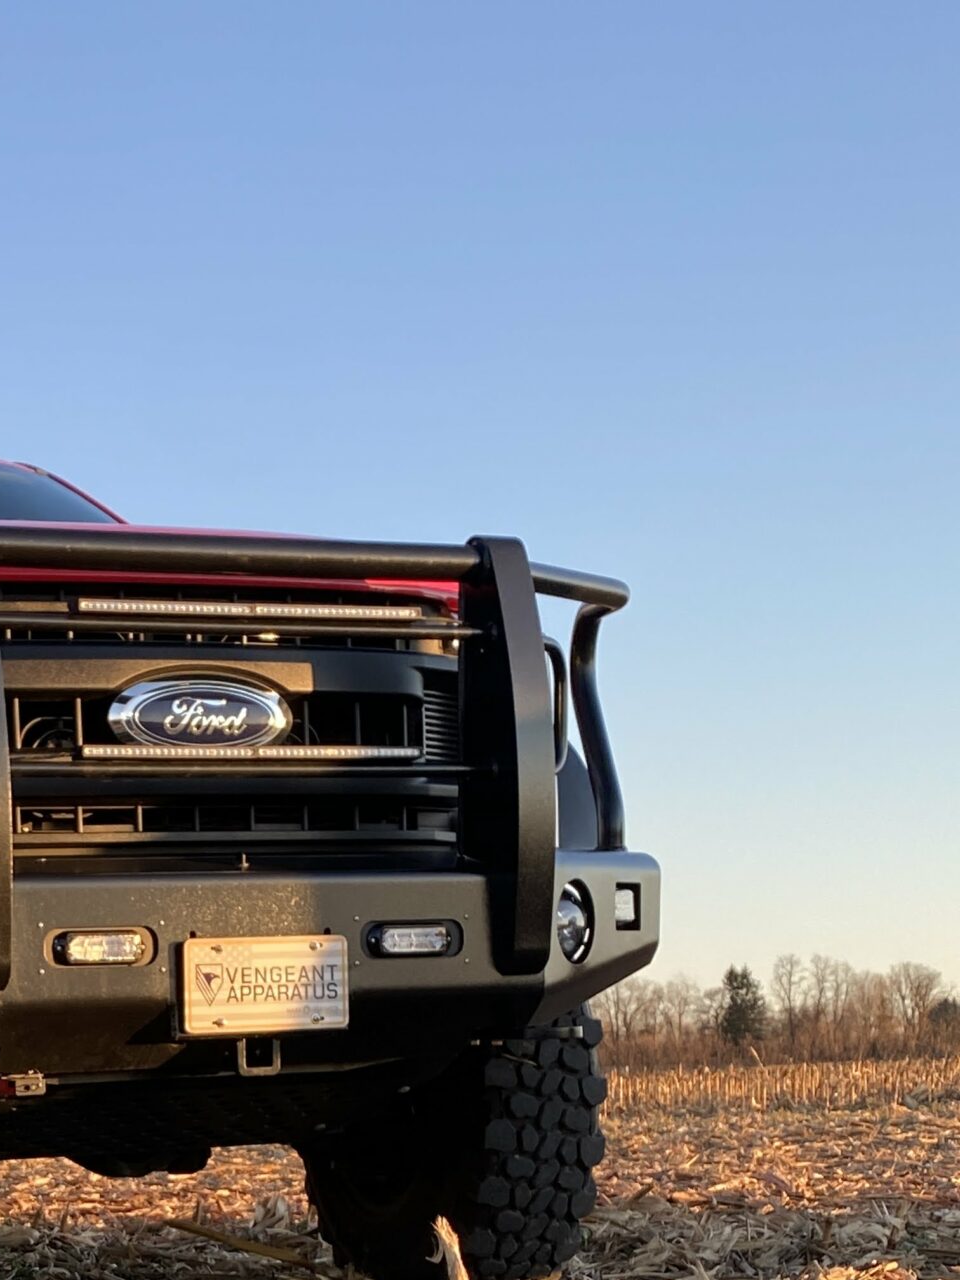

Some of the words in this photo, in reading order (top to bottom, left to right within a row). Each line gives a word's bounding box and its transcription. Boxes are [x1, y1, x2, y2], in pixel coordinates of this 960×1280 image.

[164, 697, 247, 736] Ford
[225, 964, 338, 984] VENGEANT
[226, 982, 338, 1003] APPARATUS
